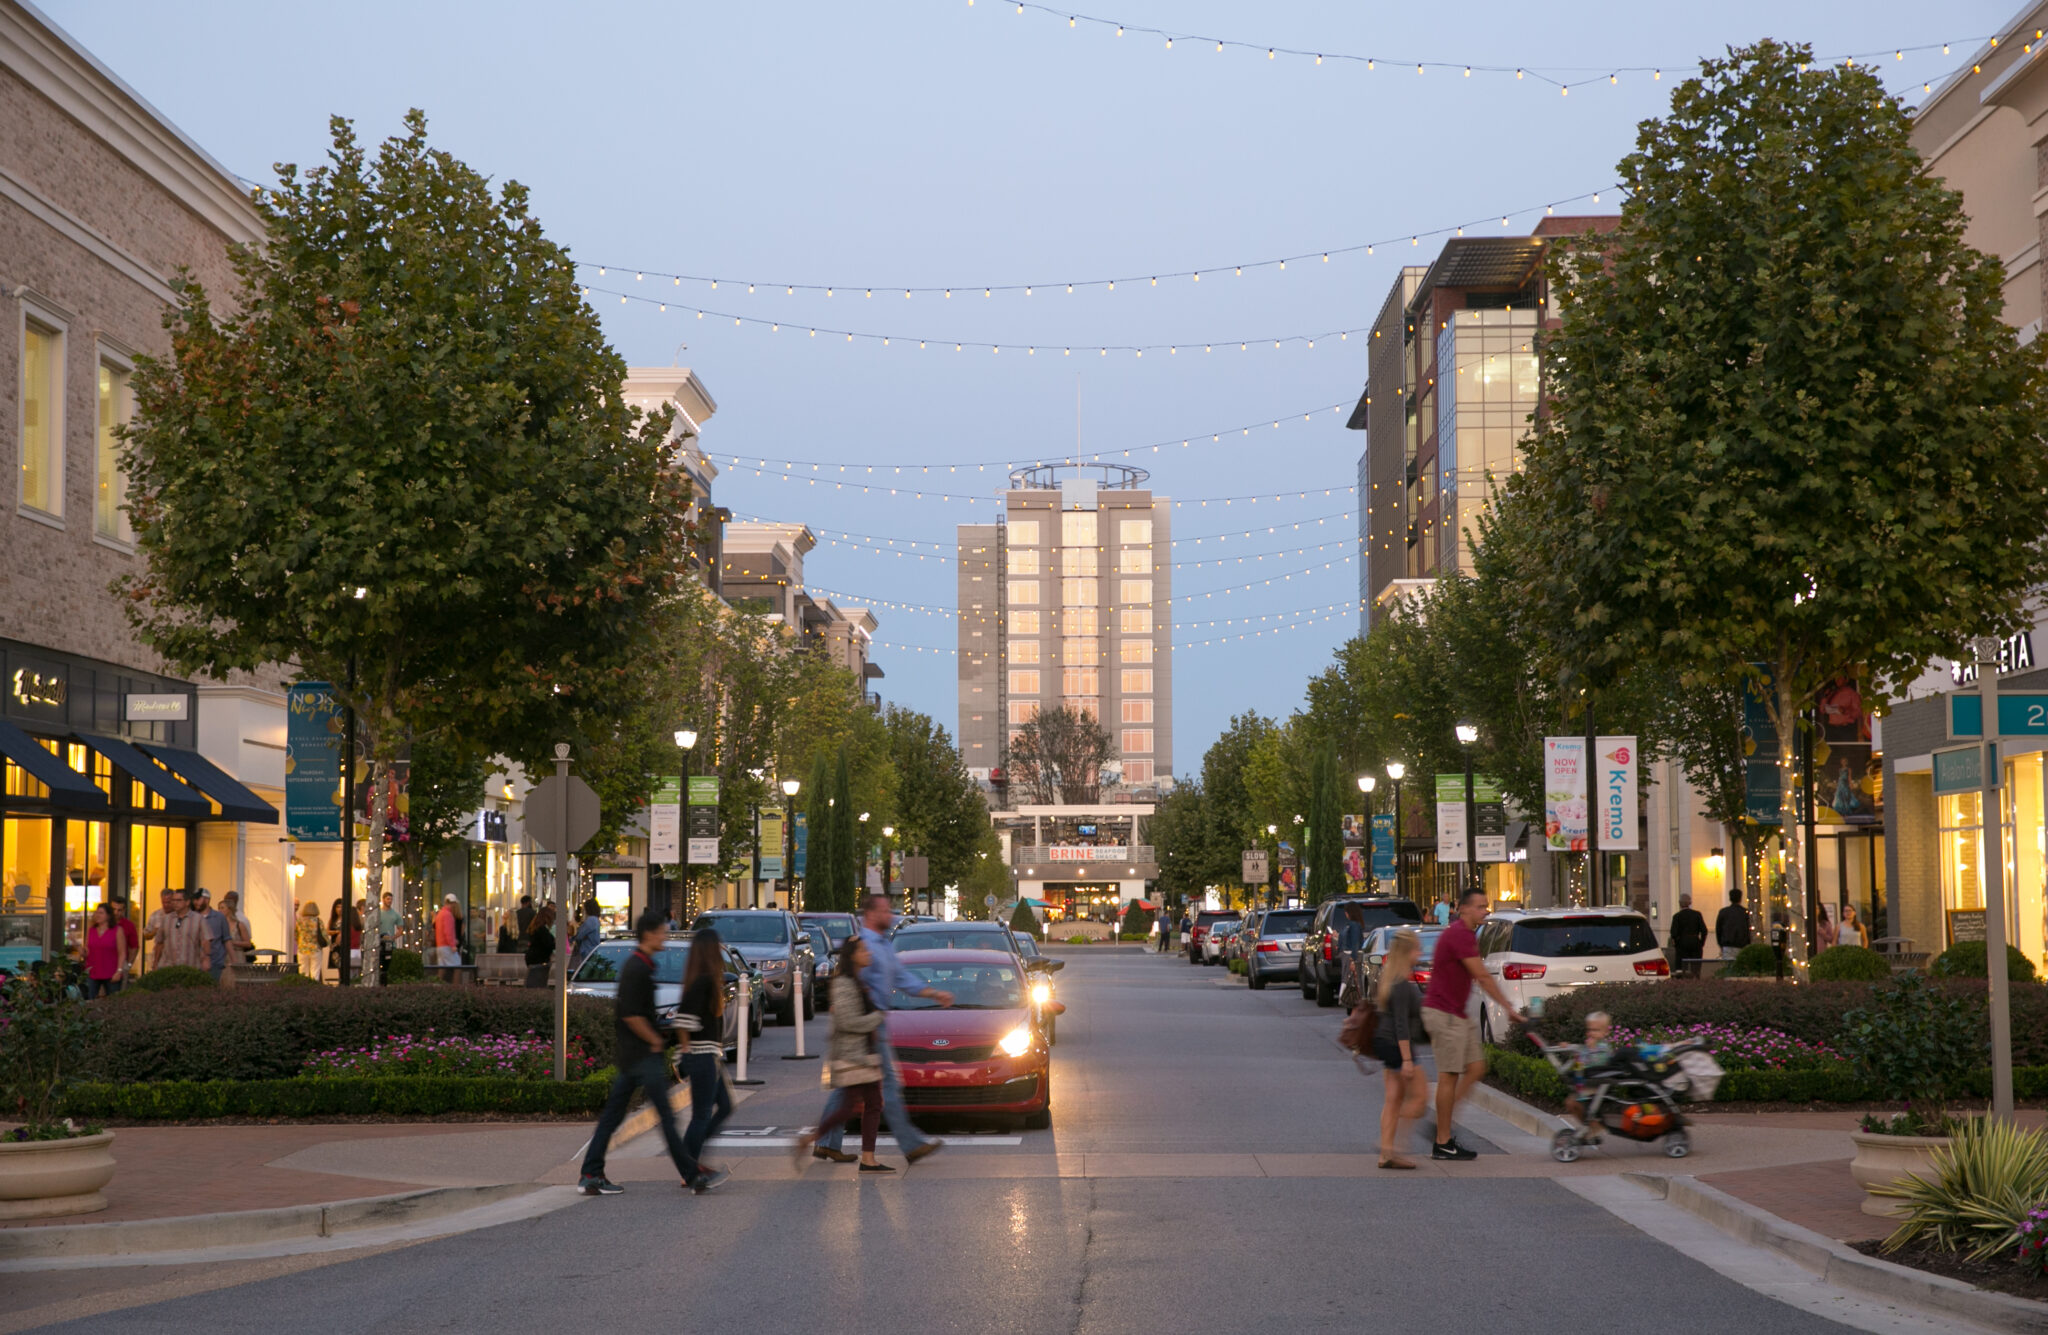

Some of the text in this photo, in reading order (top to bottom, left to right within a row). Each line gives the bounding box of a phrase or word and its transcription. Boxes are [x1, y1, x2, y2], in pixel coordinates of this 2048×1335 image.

[2027, 704, 2048, 726] 2
[1554, 758, 1577, 766] NOW
[1609, 770, 1627, 840] Kremo
[1050, 848, 1094, 859] BRINE
[1245, 852, 1265, 860] SLOW
